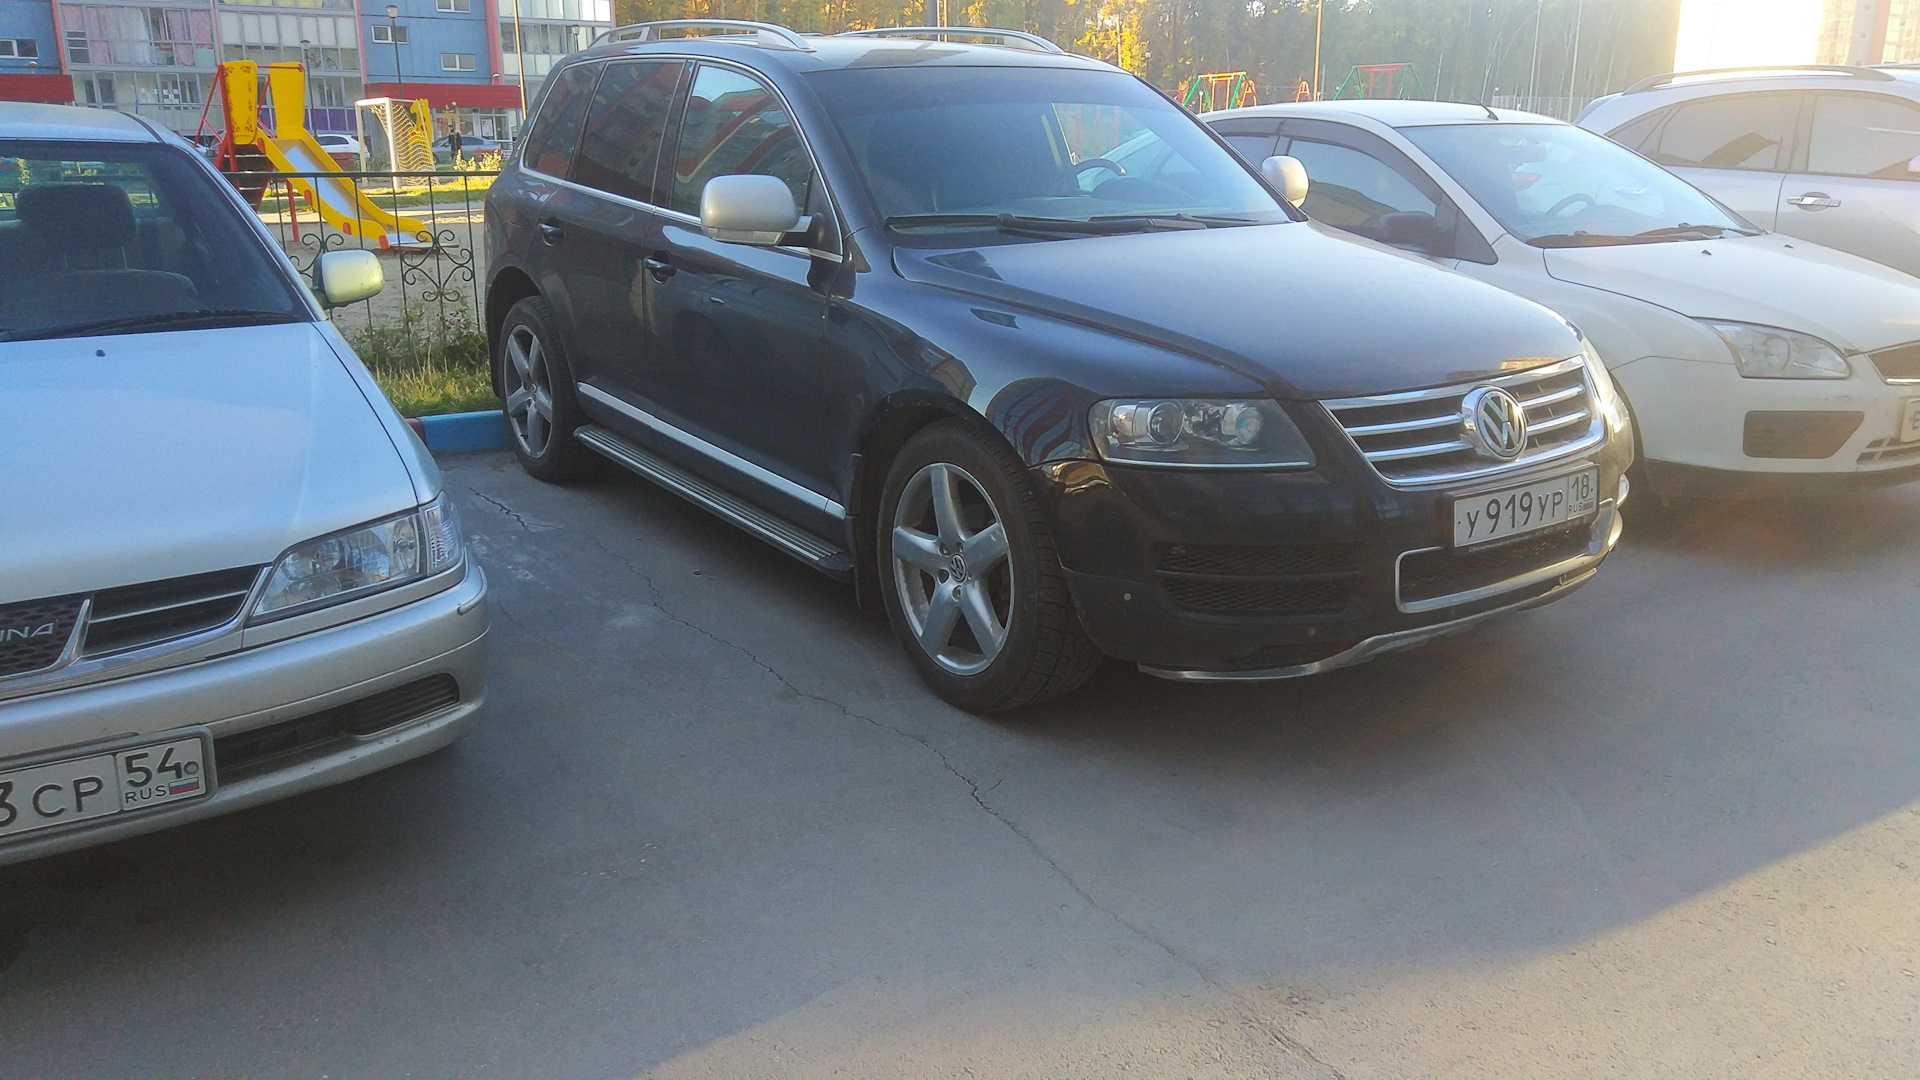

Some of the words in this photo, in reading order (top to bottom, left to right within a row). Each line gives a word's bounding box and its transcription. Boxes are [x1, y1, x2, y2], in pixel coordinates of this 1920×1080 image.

[1572, 473, 1590, 501] 18
[1568, 501, 1583, 512] RUS
[125, 747, 183, 787] 54
[125, 785, 167, 803] RUS
